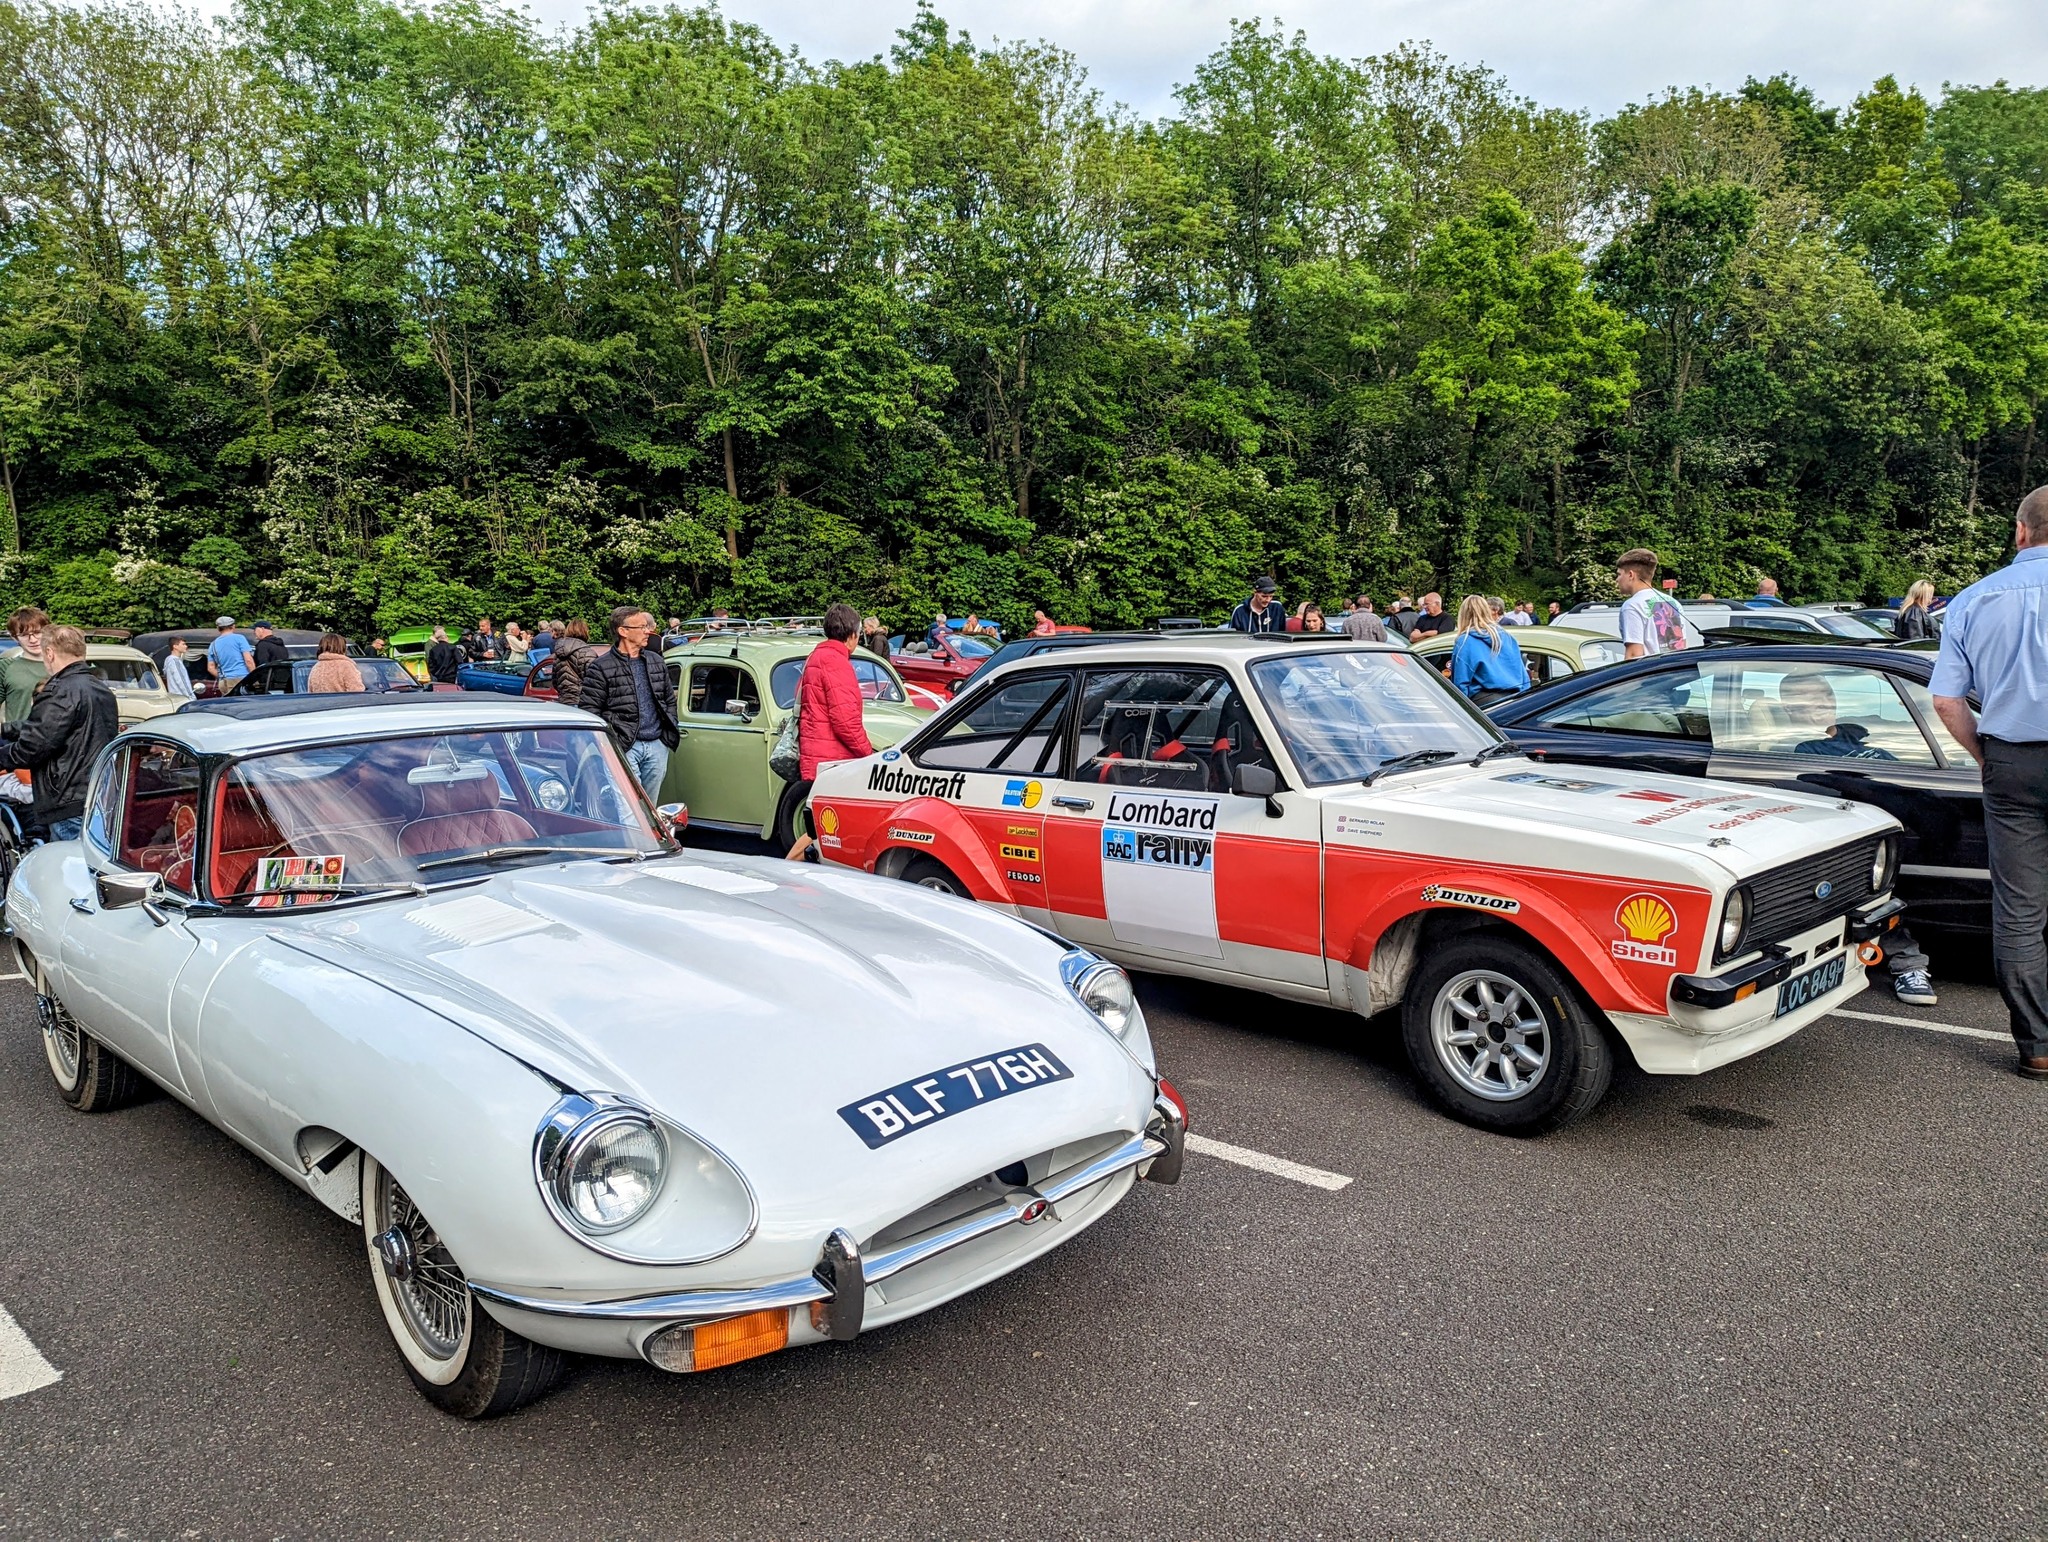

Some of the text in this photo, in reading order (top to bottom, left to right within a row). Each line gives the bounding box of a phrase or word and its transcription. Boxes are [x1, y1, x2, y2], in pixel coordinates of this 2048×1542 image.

[868, 763, 966, 799] Motorcraft
[1107, 795, 1219, 830] Lombard
[1631, 806, 1691, 826] WALLIS
[821, 836, 842, 847] Shell
[895, 830, 933, 842] DUNLOP
[1360, 829, 1383, 837] SHEPHERD
[1106, 832, 1210, 867] RAC rally
[1007, 870, 1041, 882] FERODO
[1438, 889, 1517, 910] DUNLOP
[1612, 943, 1675, 964] Shell
[1778, 956, 1846, 1015] LOC 849P
[858, 1048, 1061, 1137] BLF 776H
